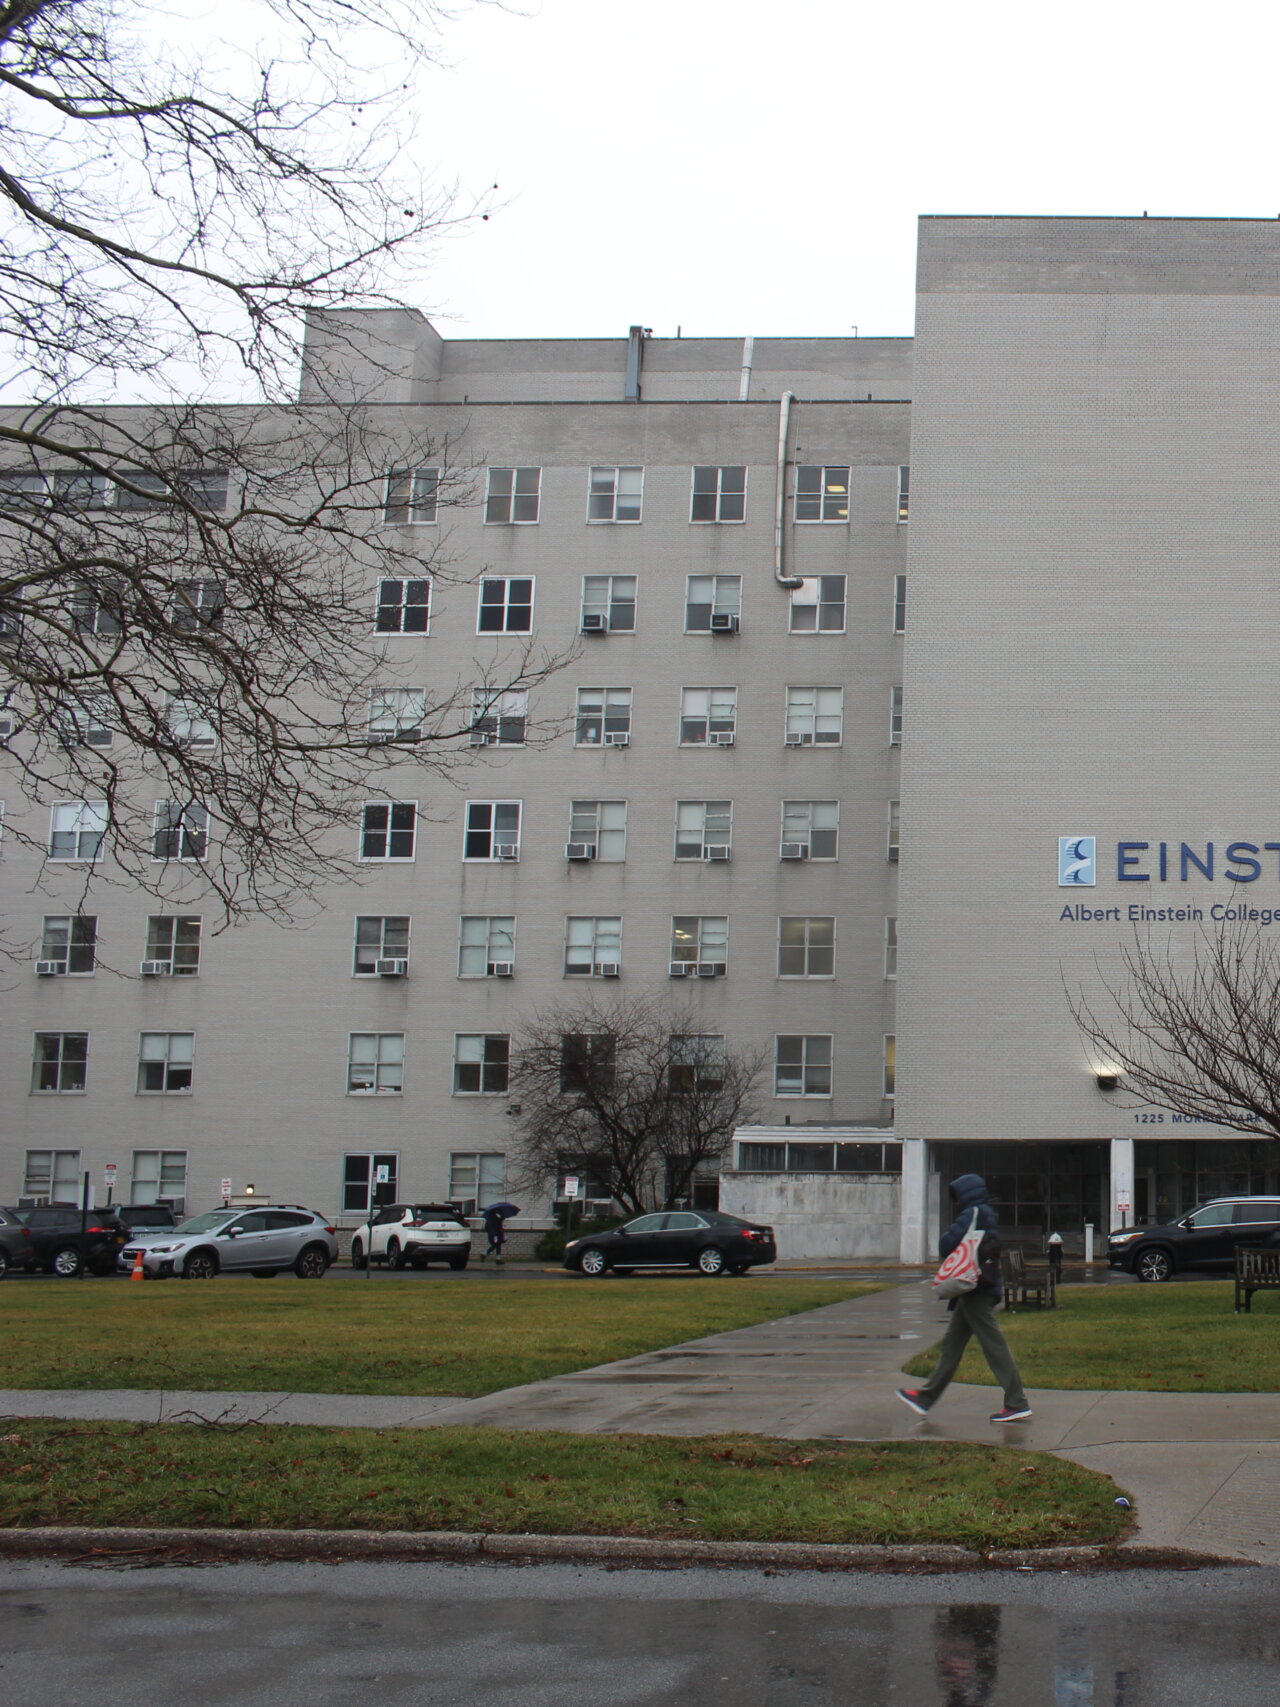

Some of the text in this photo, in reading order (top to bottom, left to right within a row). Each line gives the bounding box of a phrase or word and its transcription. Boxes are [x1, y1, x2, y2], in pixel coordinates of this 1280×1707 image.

[1060, 904, 1121, 921] Albert
[1128, 904, 1203, 921] Einstein
[1134, 1113, 1165, 1123] 1225
